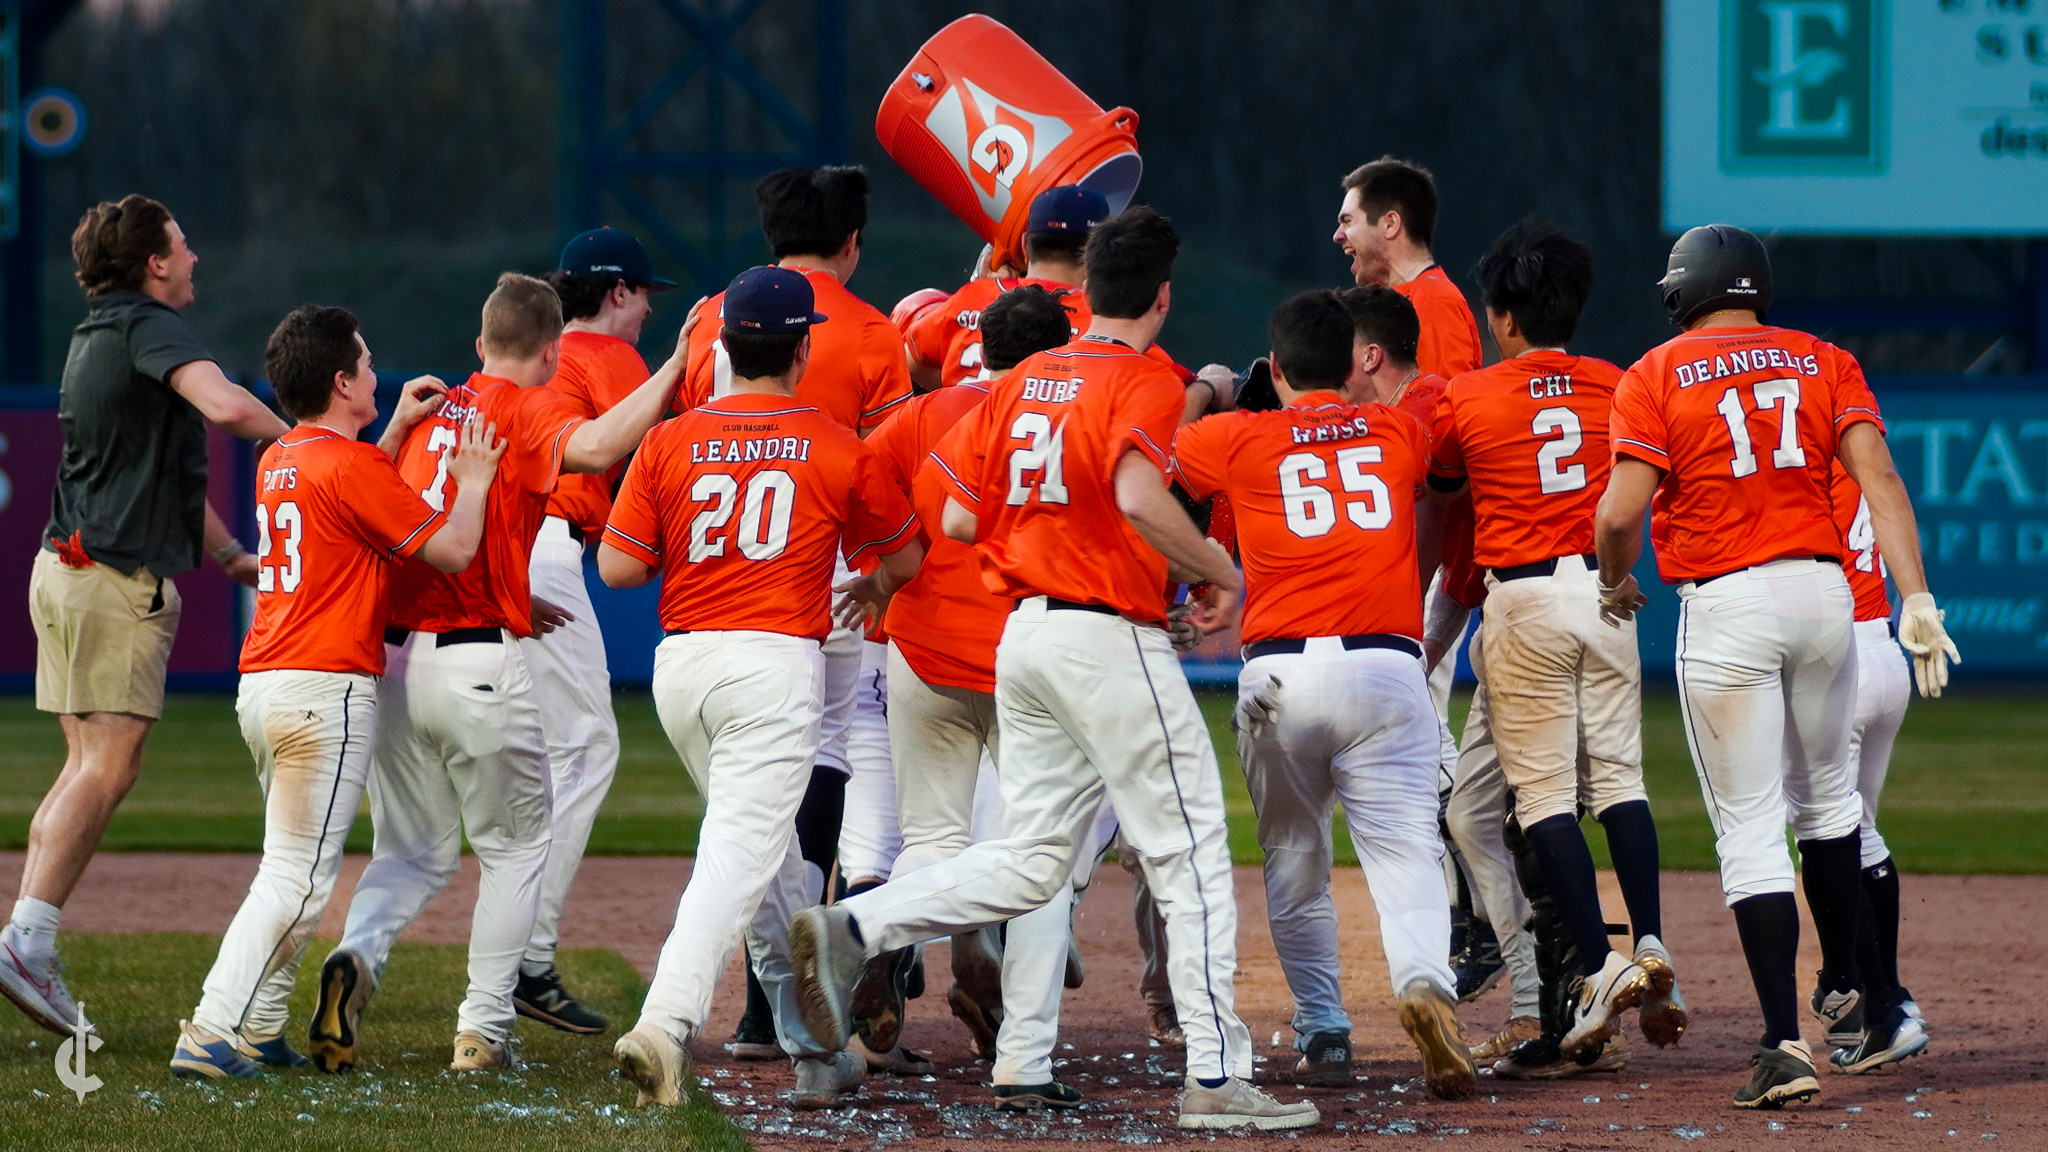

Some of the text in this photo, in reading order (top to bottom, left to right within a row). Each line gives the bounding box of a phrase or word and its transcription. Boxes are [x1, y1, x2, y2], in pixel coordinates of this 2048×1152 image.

[1529, 375, 1574, 399] CHI
[1675, 348, 1819, 389] DEANGELIS
[691, 436, 811, 464] LEANDRI
[722, 423, 780, 432] CLUB BASEBALL
[1006, 411, 1070, 506] 21
[1291, 417, 1369, 444] WEISS
[1531, 405, 1588, 496] 2
[1716, 377, 1807, 479] 17
[688, 468, 797, 564] 20
[1278, 445, 1393, 539] 65
[256, 501, 302, 594] 23
